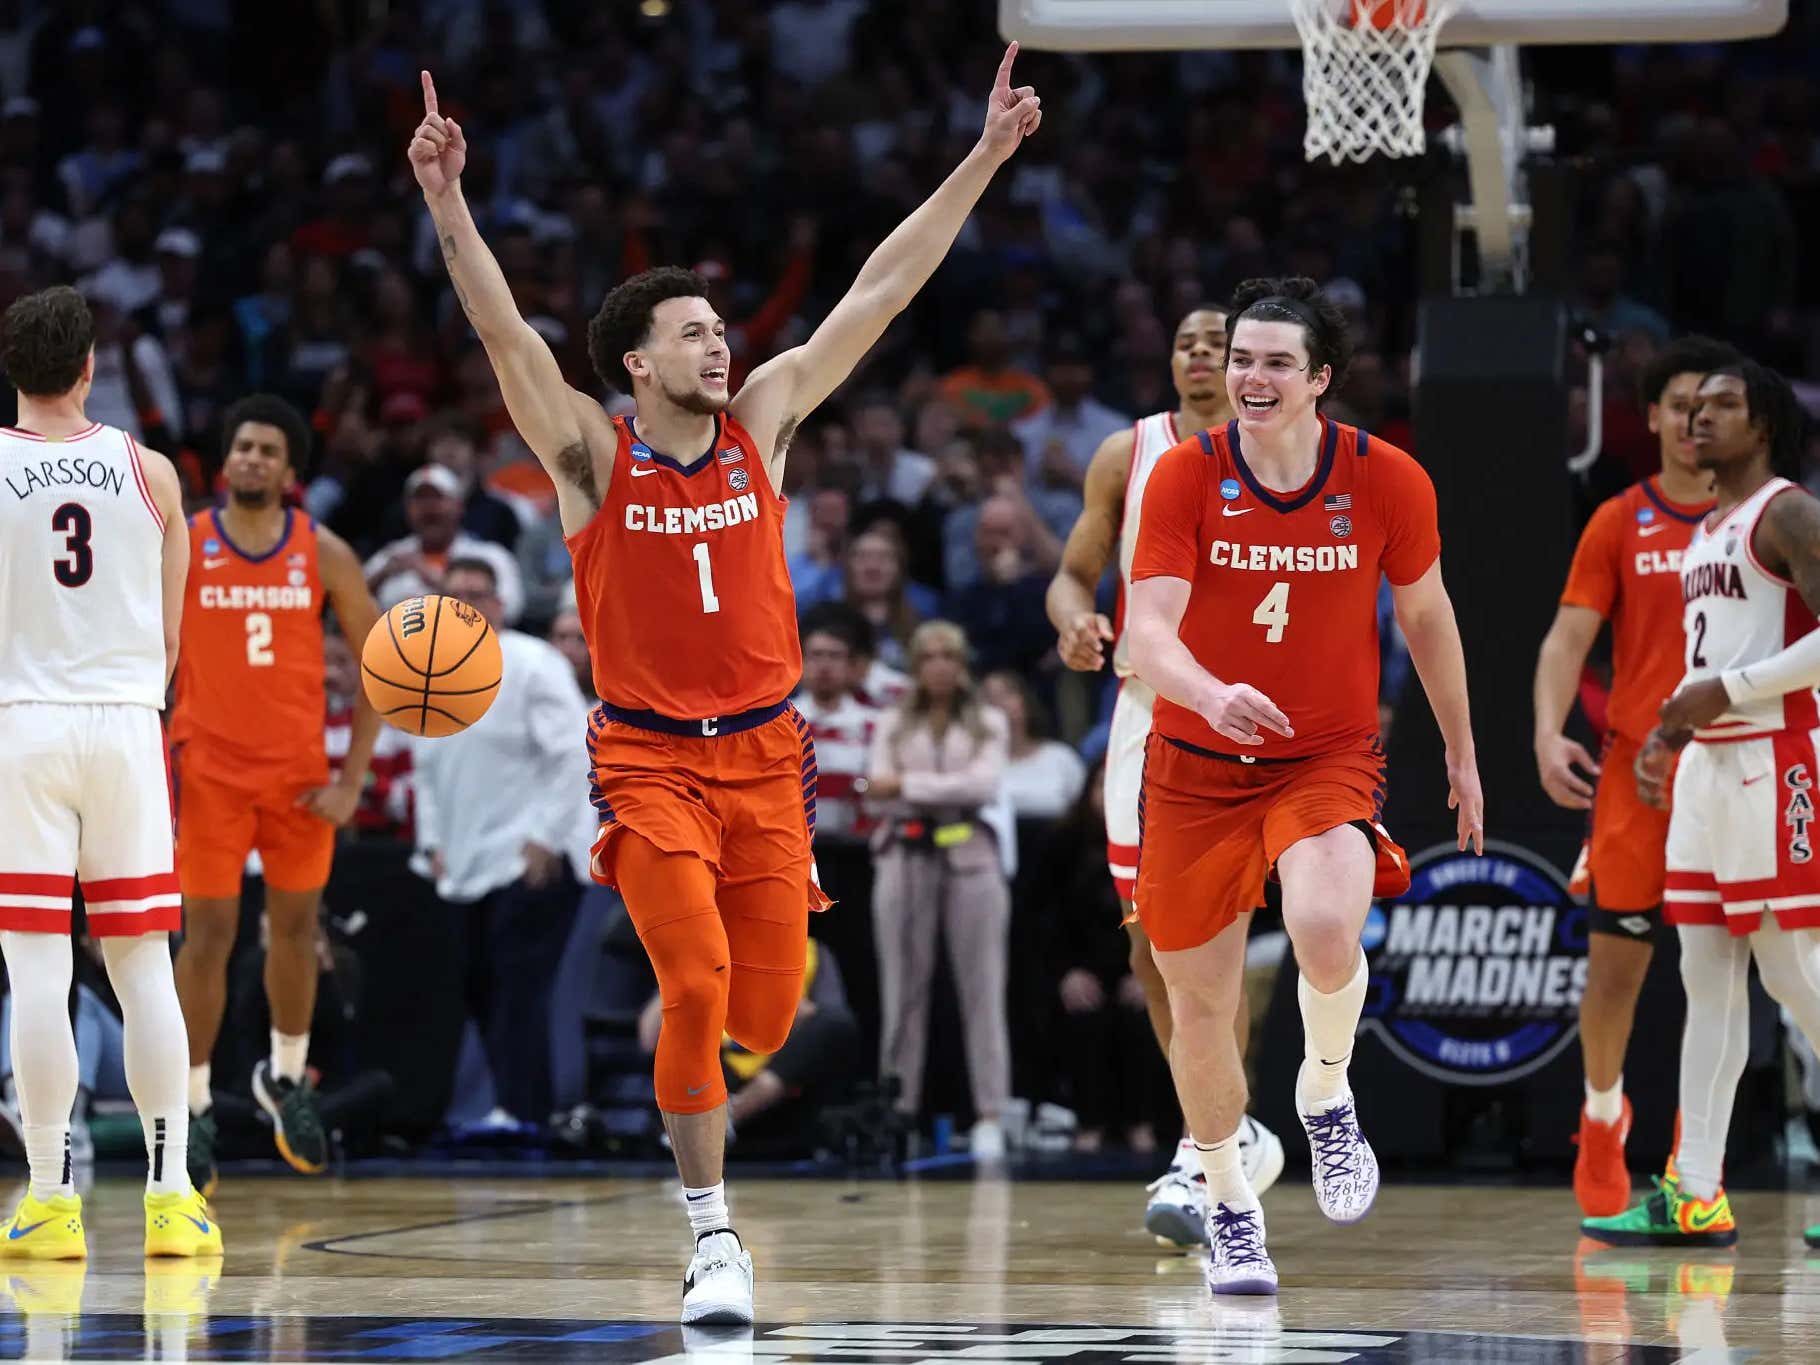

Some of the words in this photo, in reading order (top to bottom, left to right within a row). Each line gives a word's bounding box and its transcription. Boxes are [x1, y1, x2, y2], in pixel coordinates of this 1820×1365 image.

[5, 458, 125, 500] LARSSON
[625, 492, 759, 534] CLEMSON
[52, 502, 93, 588] 3
[1209, 540, 1358, 572] CLEMSON
[200, 586, 311, 608] CLEMSON
[692, 542, 720, 613] 1
[1252, 581, 1290, 643] 4
[245, 612, 274, 666] 2
[1693, 611, 1706, 668] 2
[702, 717, 718, 736] C
[1784, 763, 1815, 864] CATS
[1386, 905, 1556, 955] MARCH
